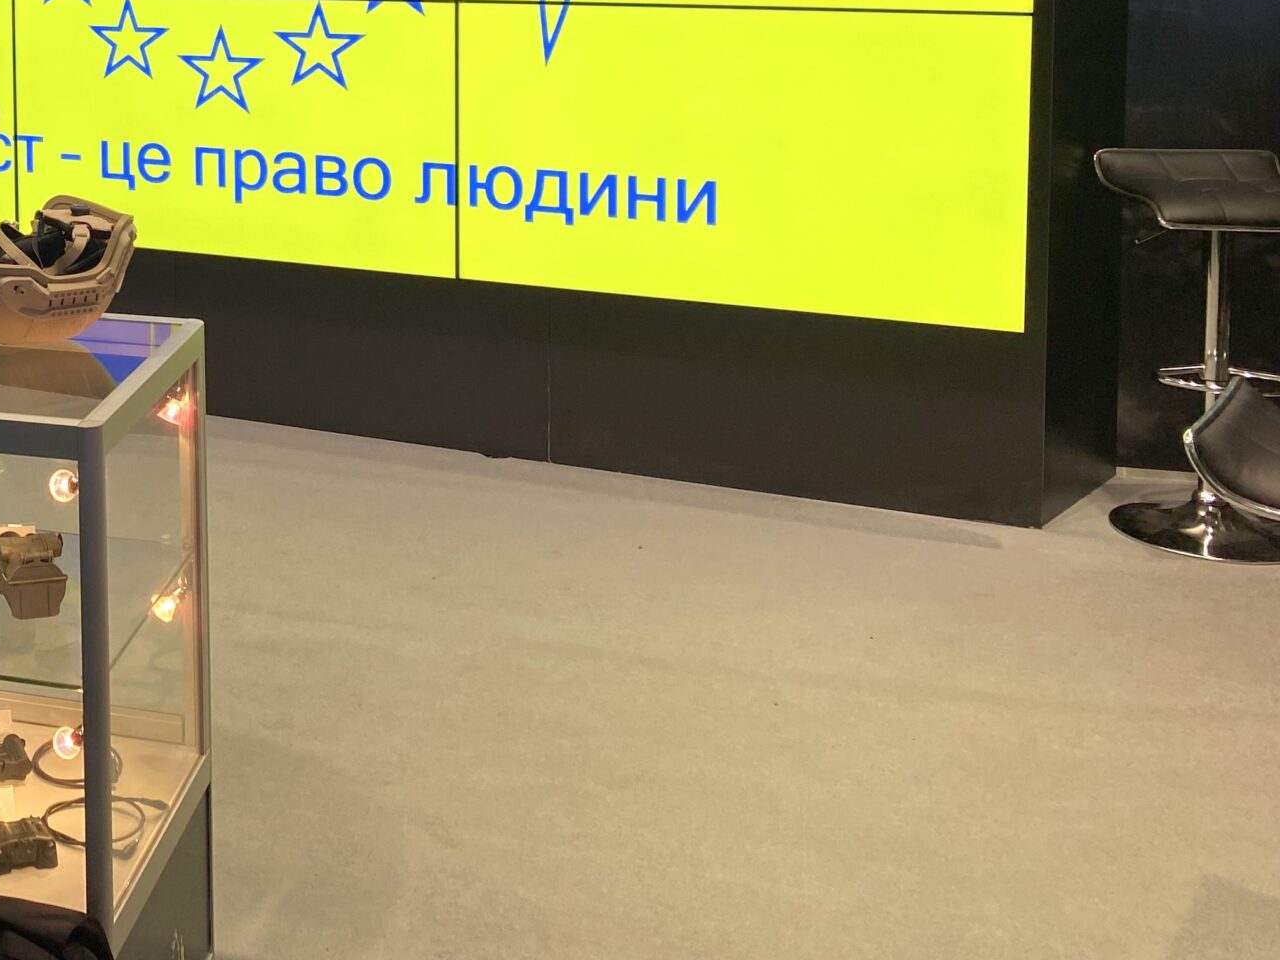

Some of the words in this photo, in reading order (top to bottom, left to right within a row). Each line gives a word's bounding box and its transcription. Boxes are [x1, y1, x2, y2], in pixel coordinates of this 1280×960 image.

[101, 138, 172, 191] це
[194, 145, 393, 204] право
[414, 162, 718, 226] людини
